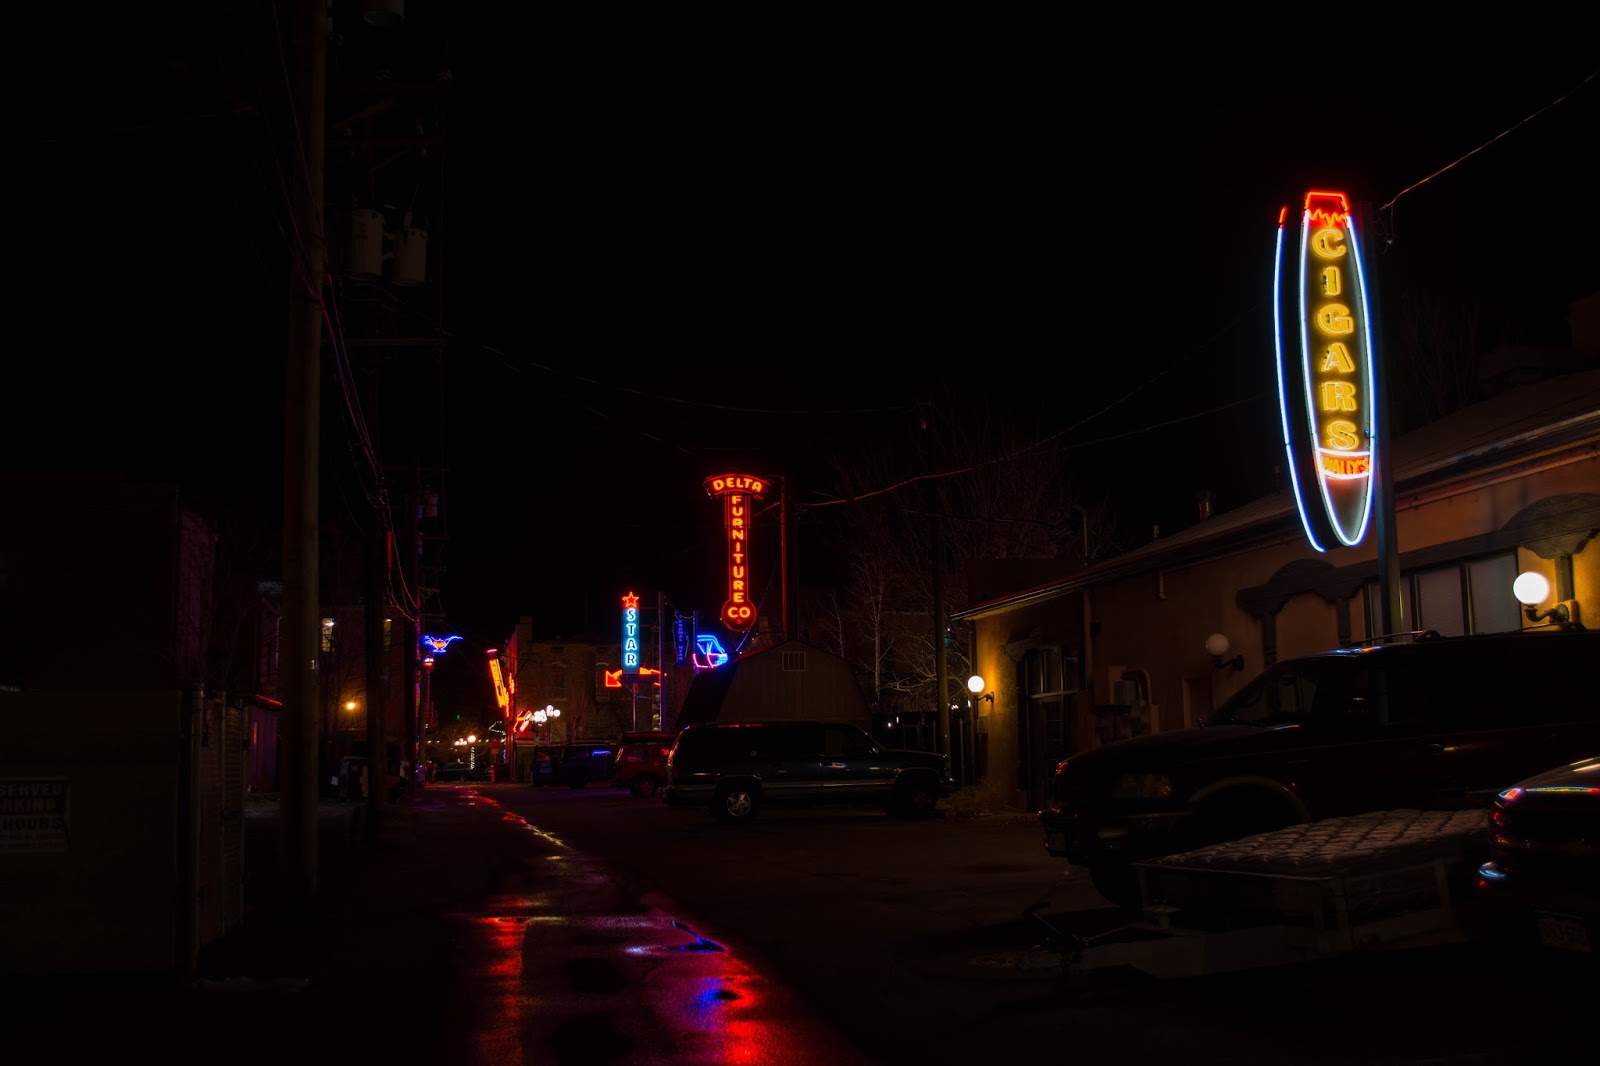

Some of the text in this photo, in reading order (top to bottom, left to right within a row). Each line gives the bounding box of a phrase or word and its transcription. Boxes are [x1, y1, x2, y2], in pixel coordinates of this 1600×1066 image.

[1312, 229, 1358, 452] CIGARS
[712, 477, 763, 492] DELTA
[731, 495, 745, 603] FURNITURE
[624, 607, 639, 666] STAR
[727, 606, 751, 619] CO
